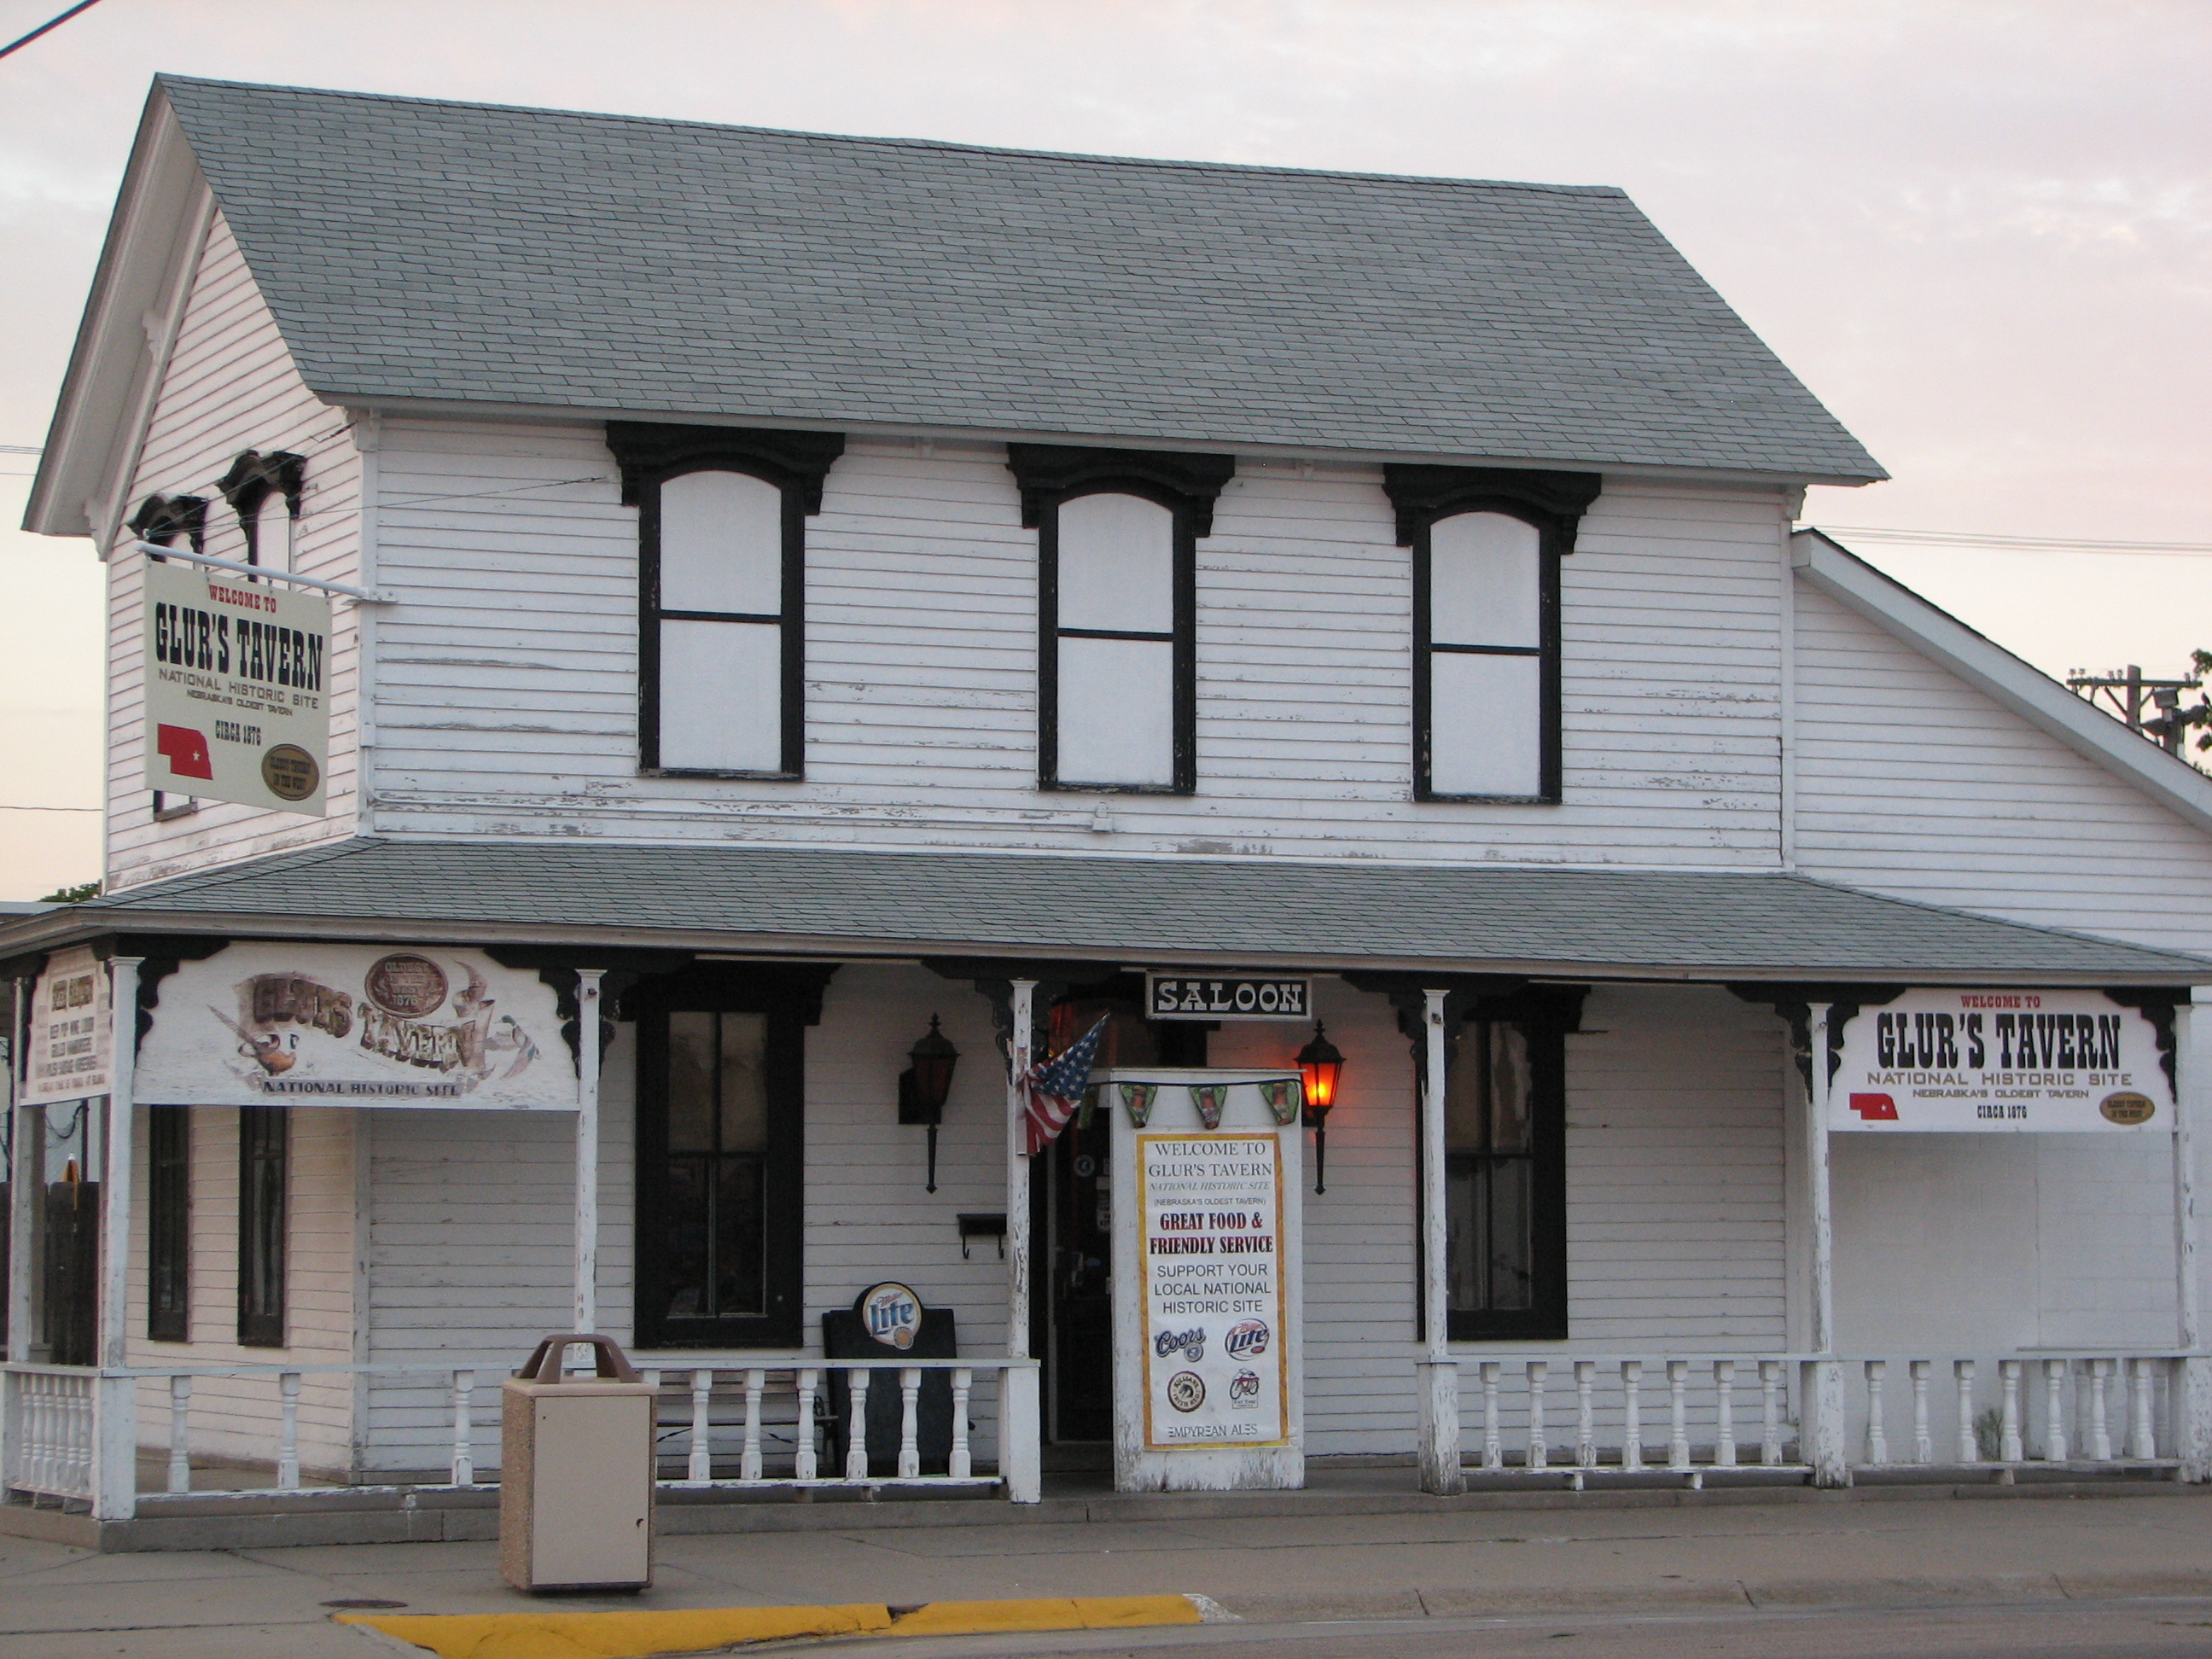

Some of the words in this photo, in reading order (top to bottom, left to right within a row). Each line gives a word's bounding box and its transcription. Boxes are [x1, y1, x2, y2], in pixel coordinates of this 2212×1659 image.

[209, 585, 260, 609] WELCOME
[263, 597, 276, 613] TO
[155, 602, 230, 674] GLUR'S
[236, 619, 323, 692] TAVERN
[159, 668, 221, 691] NATIONAL
[229, 681, 284, 703] HISTORIC
[293, 696, 318, 709] SITE
[236, 699, 265, 711] OLDEST
[266, 704, 293, 716] TAVERN
[215, 719, 240, 742] CIRCA
[1157, 981, 1301, 1012] SALOON
[1961, 995, 2021, 1008] WELCOME
[2025, 995, 2040, 1009] TO
[357, 1002, 478, 1073] TAVERN
[1877, 1012, 1985, 1069] GLUR'S
[1996, 1014, 2121, 1069] TAVERN
[1867, 1072, 1969, 1086] NATIONAL
[1982, 1073, 2075, 1086] HISTORIC
[2088, 1073, 2132, 1086] SITE
[263, 1081, 344, 1094] NATIONAL
[1912, 1089, 1988, 1098] NEBRASKA'S
[1995, 1090, 2040, 1098] OLDEST
[2046, 1090, 2089, 1098] TAVERN
[1976, 1105, 2005, 1119] CIRCA
[2007, 1106, 2027, 1119] 1876
[1155, 1143, 1239, 1156] WELCOME
[1243, 1142, 1266, 1155] TO
[1148, 1164, 1205, 1178] GLUR'S
[1209, 1163, 1272, 1176] TAVERN
[1149, 1182, 1199, 1191] NATIONAL
[1200, 1182, 1244, 1190] HISTORIC
[1248, 1181, 1270, 1190] SITE
[1236, 1197, 1266, 1206] TAVERN)
[1160, 1213, 1204, 1231] GREAT
[1209, 1212, 1247, 1230] FOOD
[1251, 1211, 1263, 1229] &
[1150, 1237, 1215, 1254] FRIENDLY
[1220, 1236, 1273, 1254] SERVICE
[1157, 1265, 1225, 1278] SUPPORT
[1228, 1263, 1268, 1276] YOUR
[1155, 1283, 1200, 1295] LOCAL
[1204, 1282, 1272, 1295] NATIONAL
[1162, 1301, 1229, 1313] HISTORIC
[1232, 1300, 1263, 1313] SITE
[870, 1301, 914, 1337] Lite
[1155, 1327, 1208, 1357] Coors
[1230, 1329, 1268, 1353] Lite
[1168, 1425, 1227, 1438] EMPYREAN
[1231, 1423, 1258, 1435] ALES
